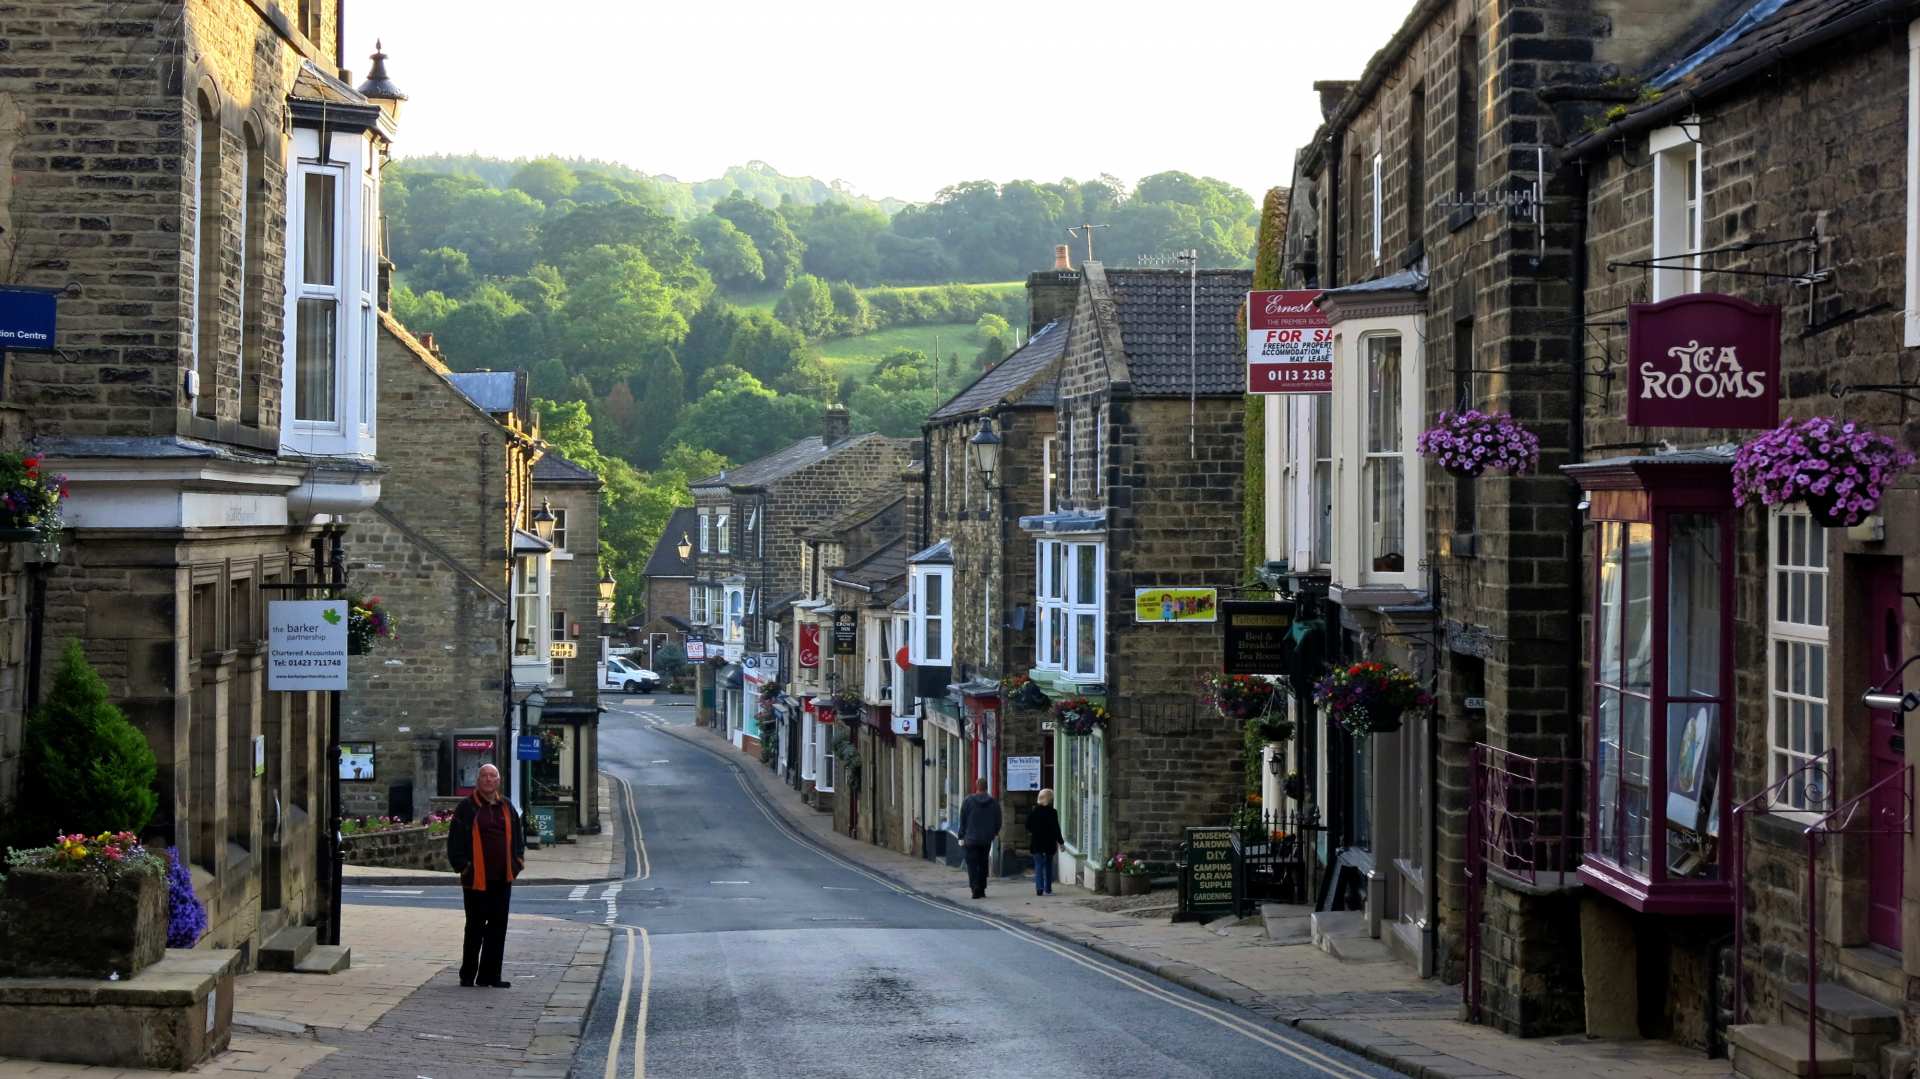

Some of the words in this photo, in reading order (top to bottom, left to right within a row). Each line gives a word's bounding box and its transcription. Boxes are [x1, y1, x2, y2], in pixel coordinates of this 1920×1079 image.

[17, 330, 47, 340] Centre
[1266, 330, 1302, 342] FOR
[1313, 329, 1332, 342] SA
[1667, 340, 1743, 373] TEA
[1268, 370, 1298, 381] 0113
[1303, 369, 1326, 380] 238
[1640, 362, 1767, 399] ROOMS
[287, 624, 319, 633] barker
[287, 634, 326, 642] partnership
[1193, 840, 1232, 848] HARDWA
[1206, 851, 1226, 860] DIY
[1194, 863, 1232, 871] CAMPING
[1194, 872, 1232, 880] CARAVA
[1200, 881, 1232, 889] SUPPLIE
